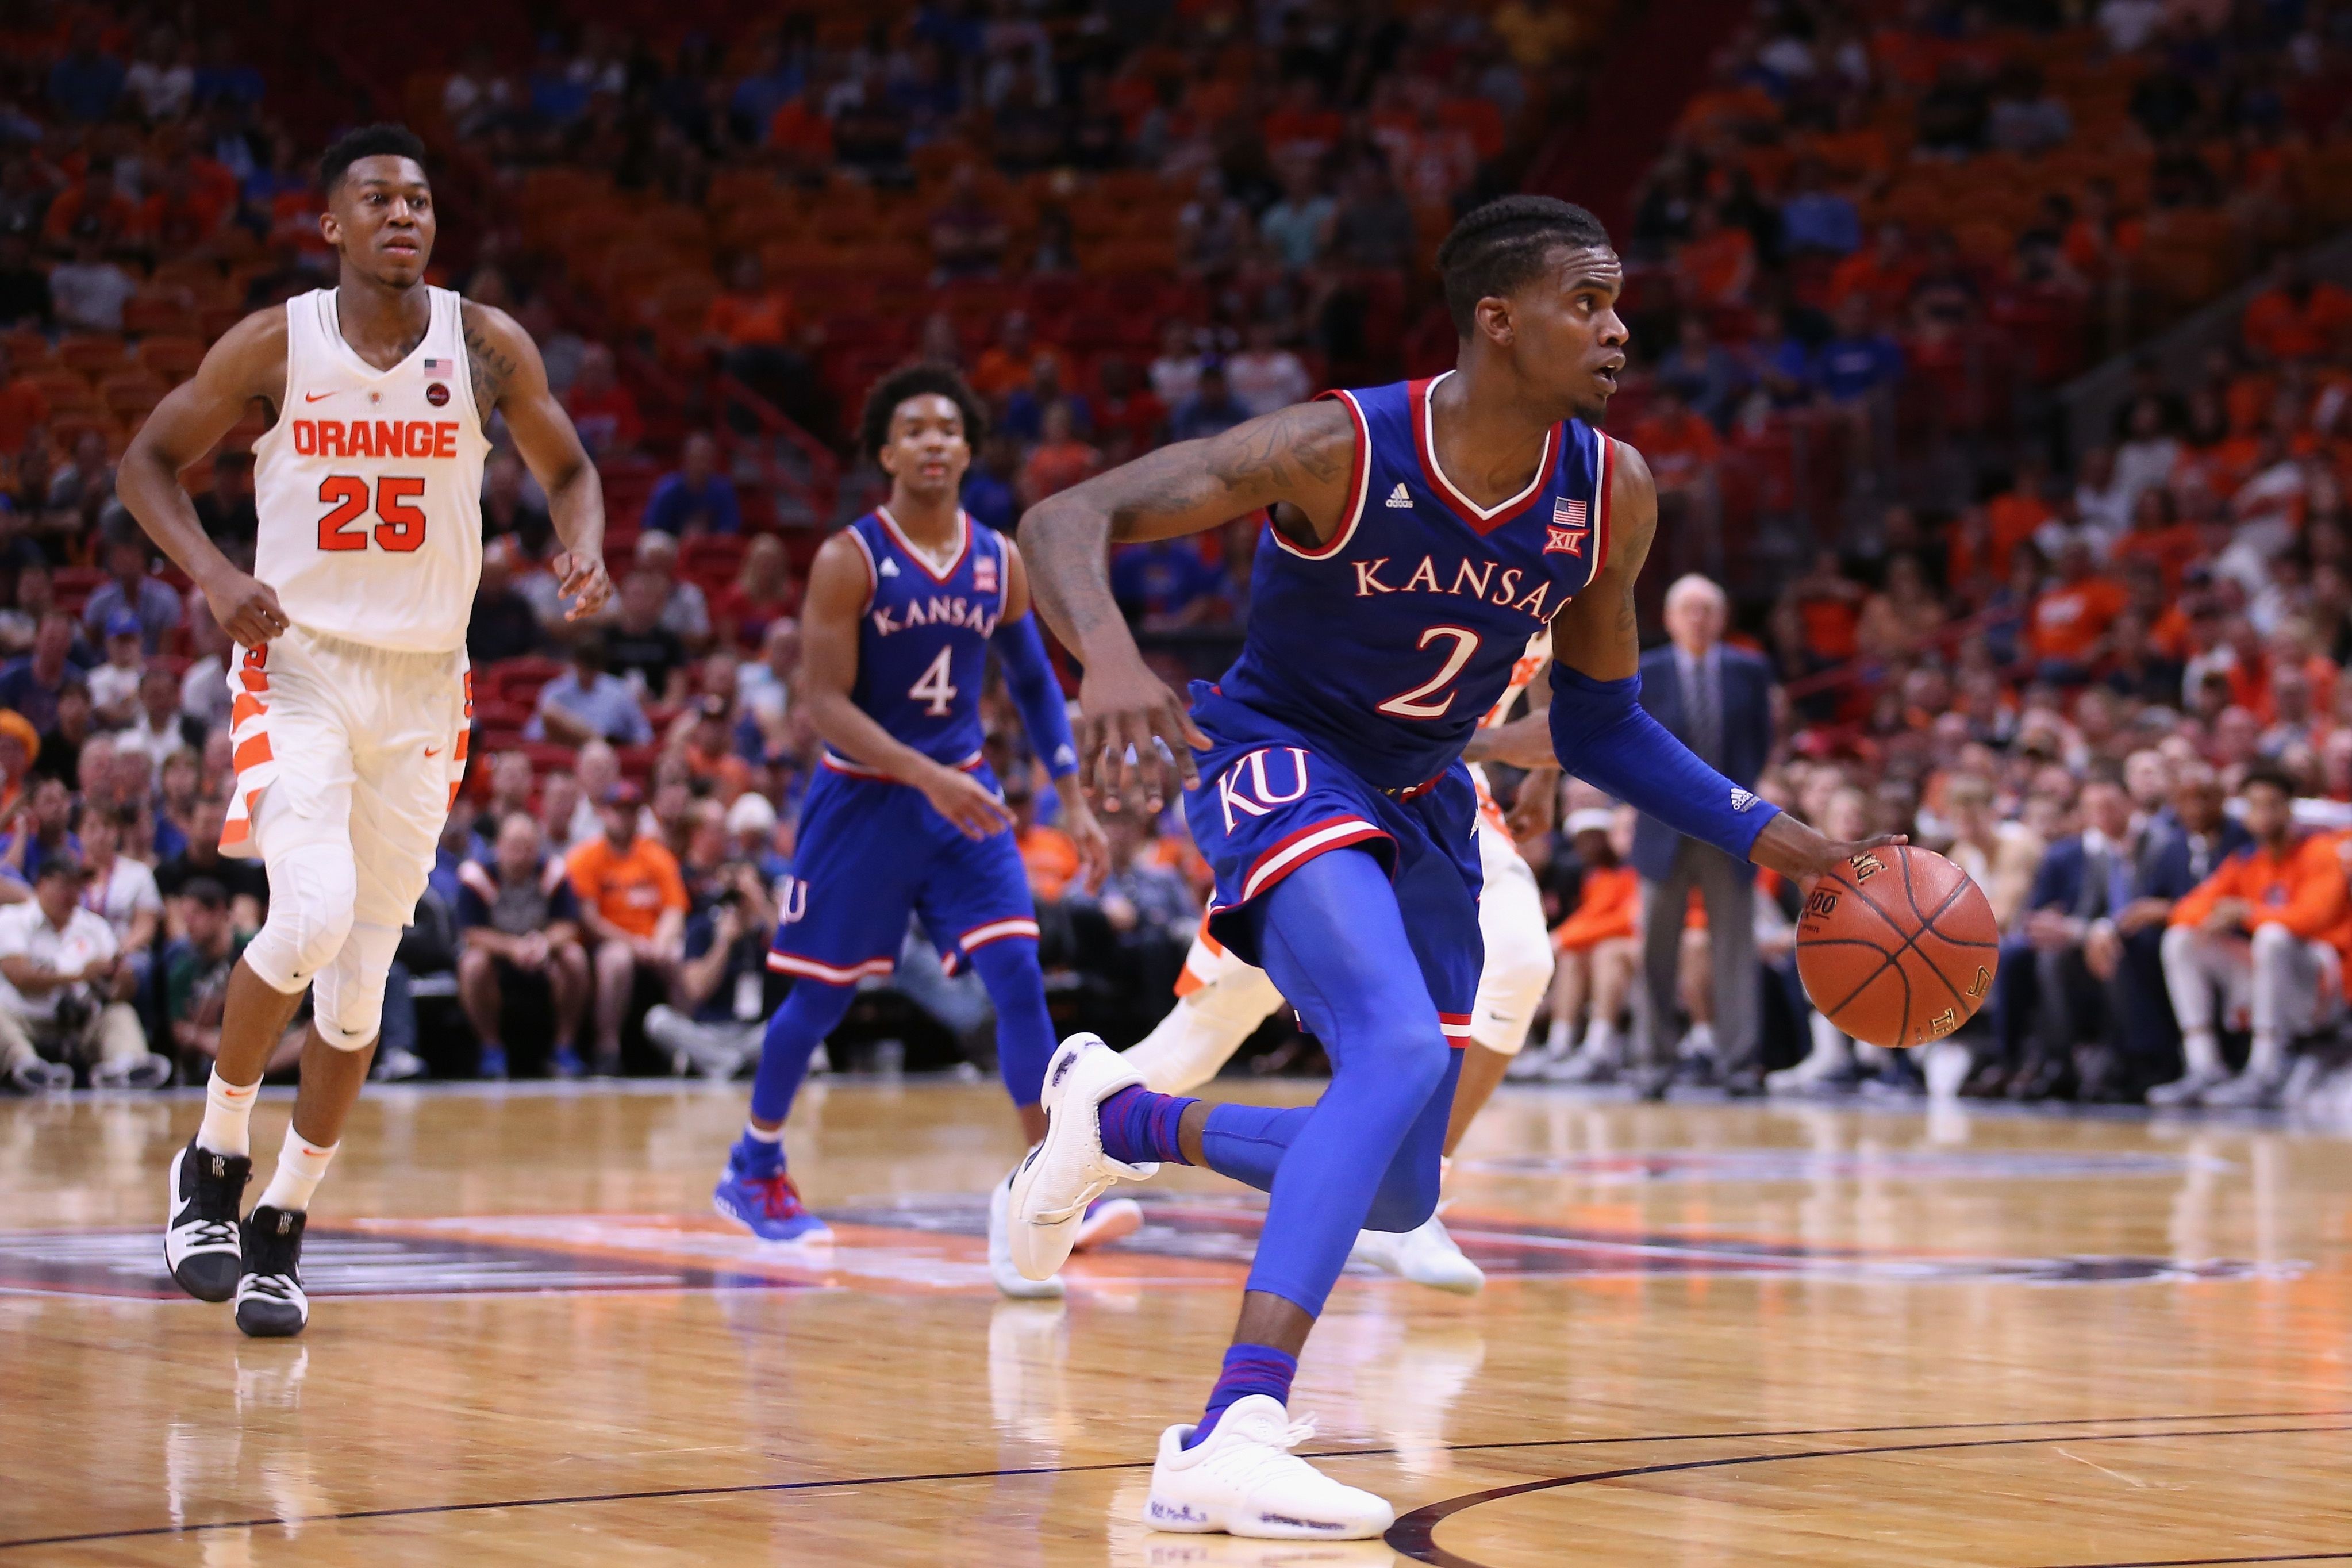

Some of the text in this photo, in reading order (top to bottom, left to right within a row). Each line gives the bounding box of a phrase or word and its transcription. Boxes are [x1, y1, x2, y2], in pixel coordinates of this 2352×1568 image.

[293, 420, 459, 457] ORANGE
[317, 476, 426, 552] 25
[908, 644, 958, 716] 4
[1375, 624, 1482, 720] 2
[1217, 747, 1310, 837] KU
